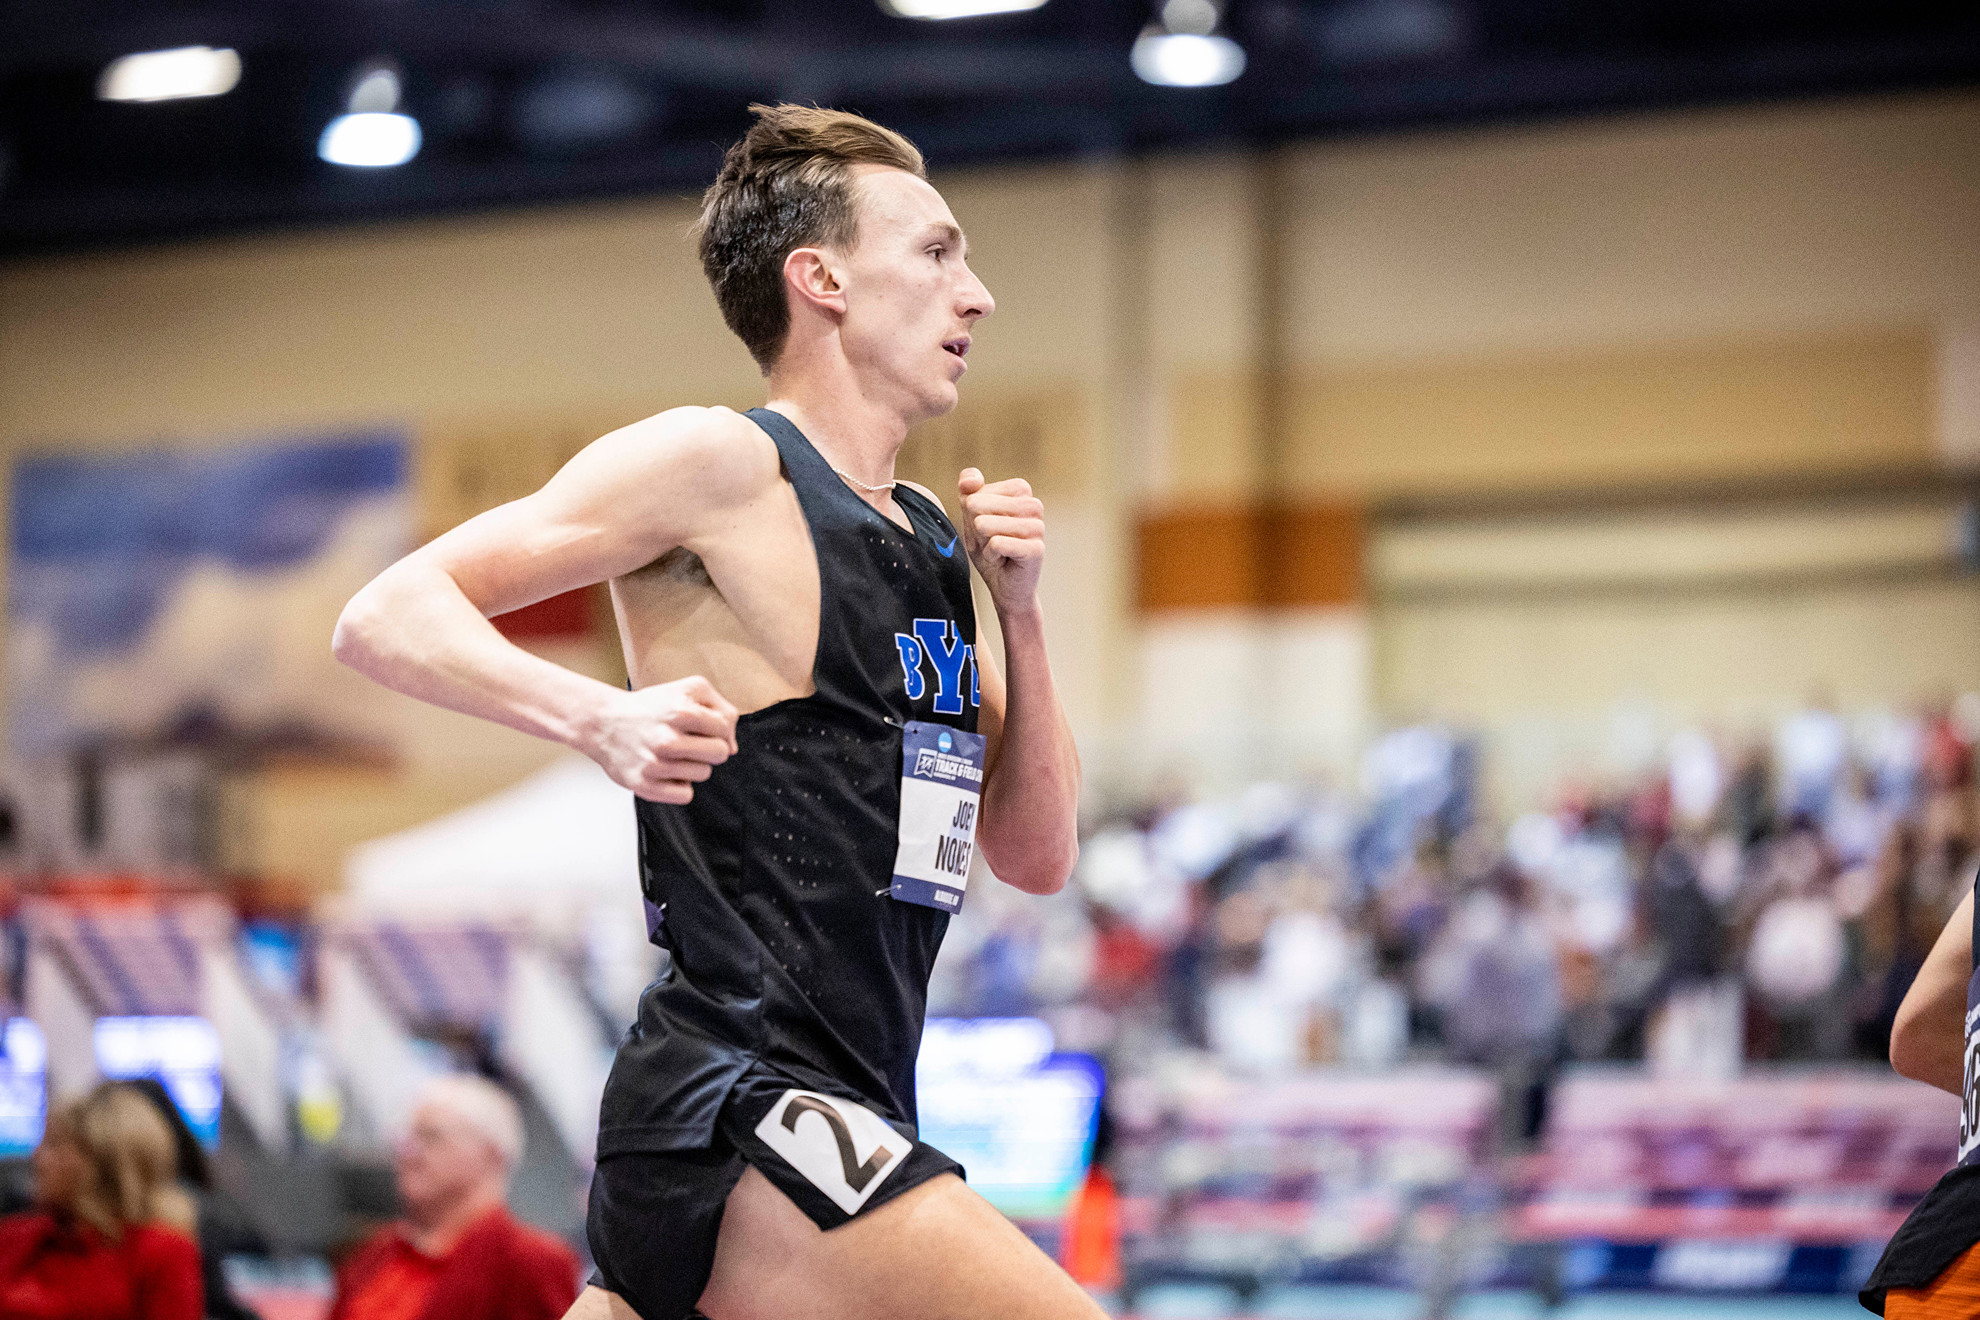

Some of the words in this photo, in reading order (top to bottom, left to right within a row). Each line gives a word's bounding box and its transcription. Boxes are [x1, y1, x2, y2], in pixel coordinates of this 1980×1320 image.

[935, 759, 959, 776] TRACK
[934, 834, 971, 877] NOKES
[781, 1095, 894, 1194] 2
